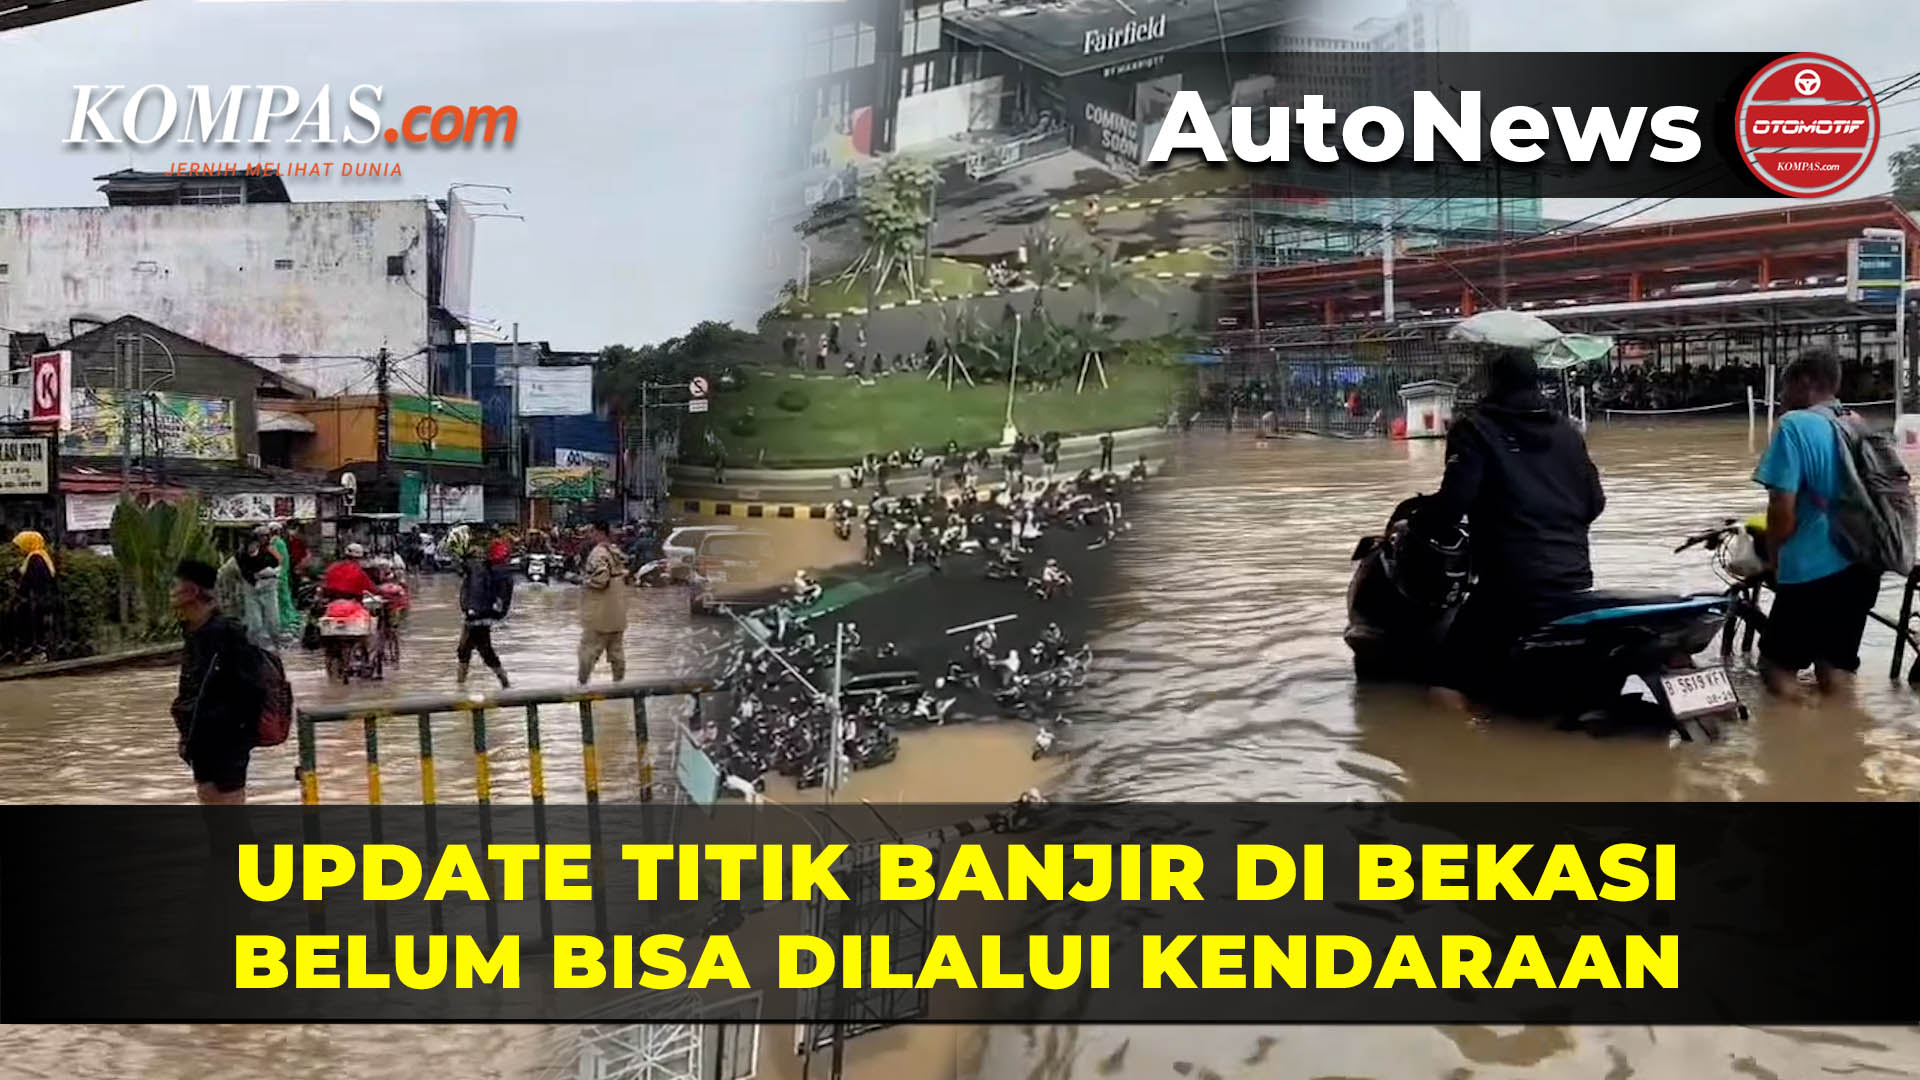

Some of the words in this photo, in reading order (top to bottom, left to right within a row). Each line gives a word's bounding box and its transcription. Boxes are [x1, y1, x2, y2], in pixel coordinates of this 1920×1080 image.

[1083, 13, 1166, 55] Fairfield
[1085, 102, 1138, 139] COMING
[1101, 129, 1138, 159] SOON
[1664, 679, 1675, 696] B
